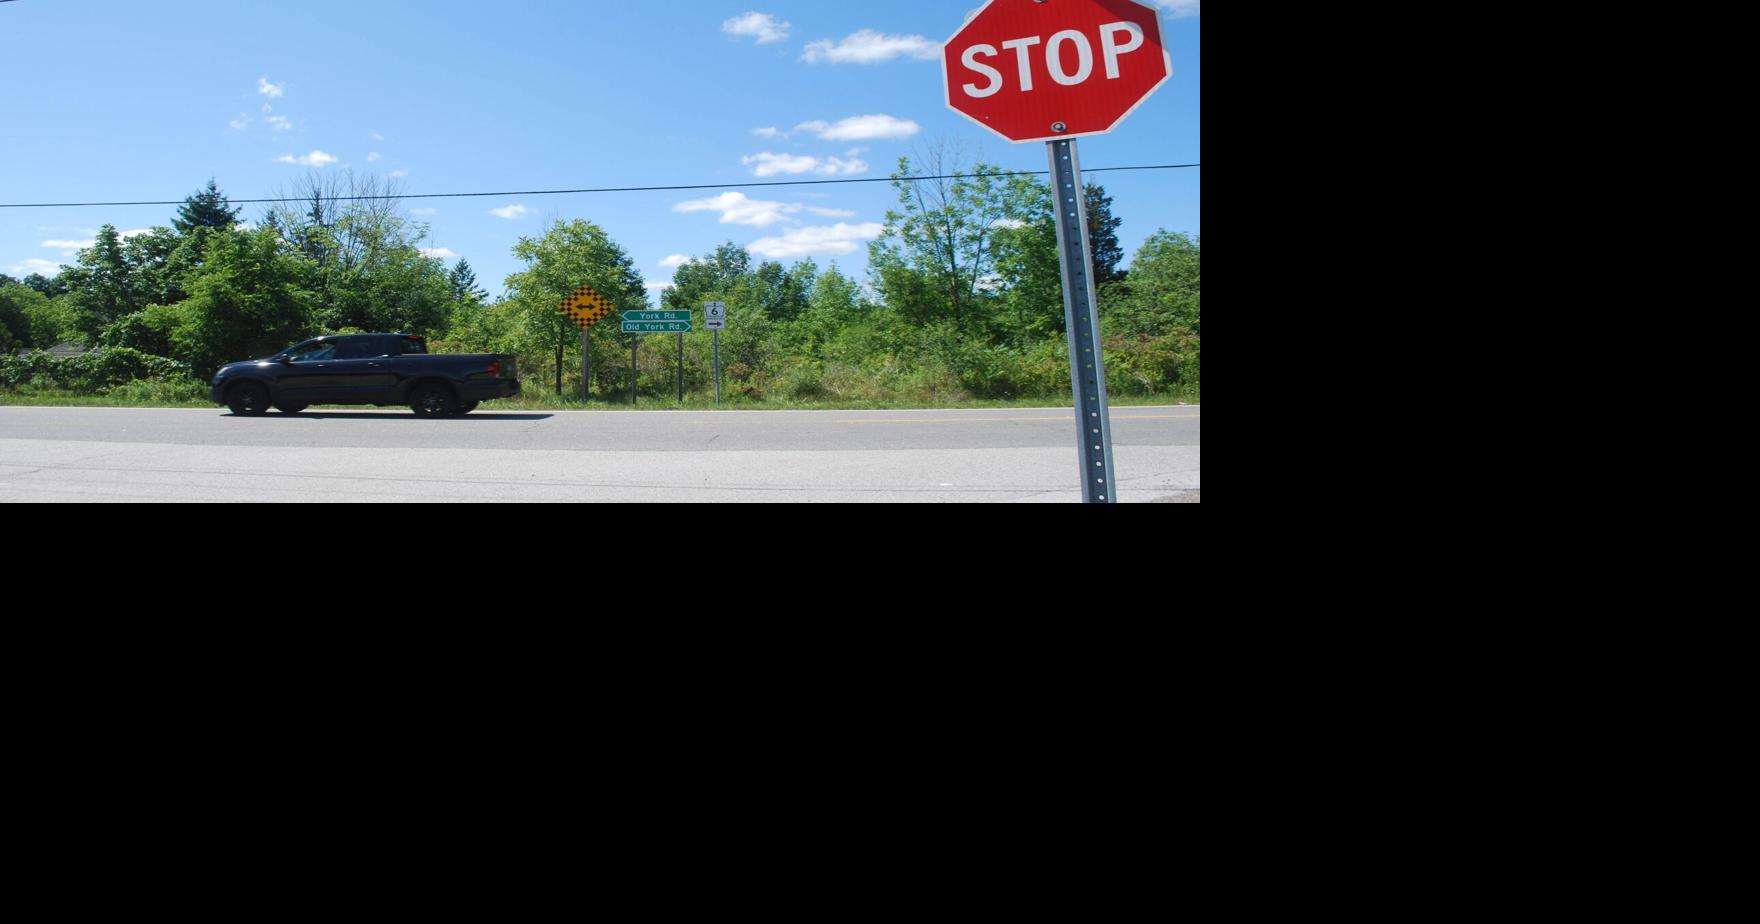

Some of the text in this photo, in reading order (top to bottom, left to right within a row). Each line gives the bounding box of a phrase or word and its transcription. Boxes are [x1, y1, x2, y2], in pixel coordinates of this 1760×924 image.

[961, 21, 1144, 98] STOP
[711, 307, 719, 316] 6
[640, 312, 678, 320] York Rd.
[626, 323, 682, 331] Old York Rd.
